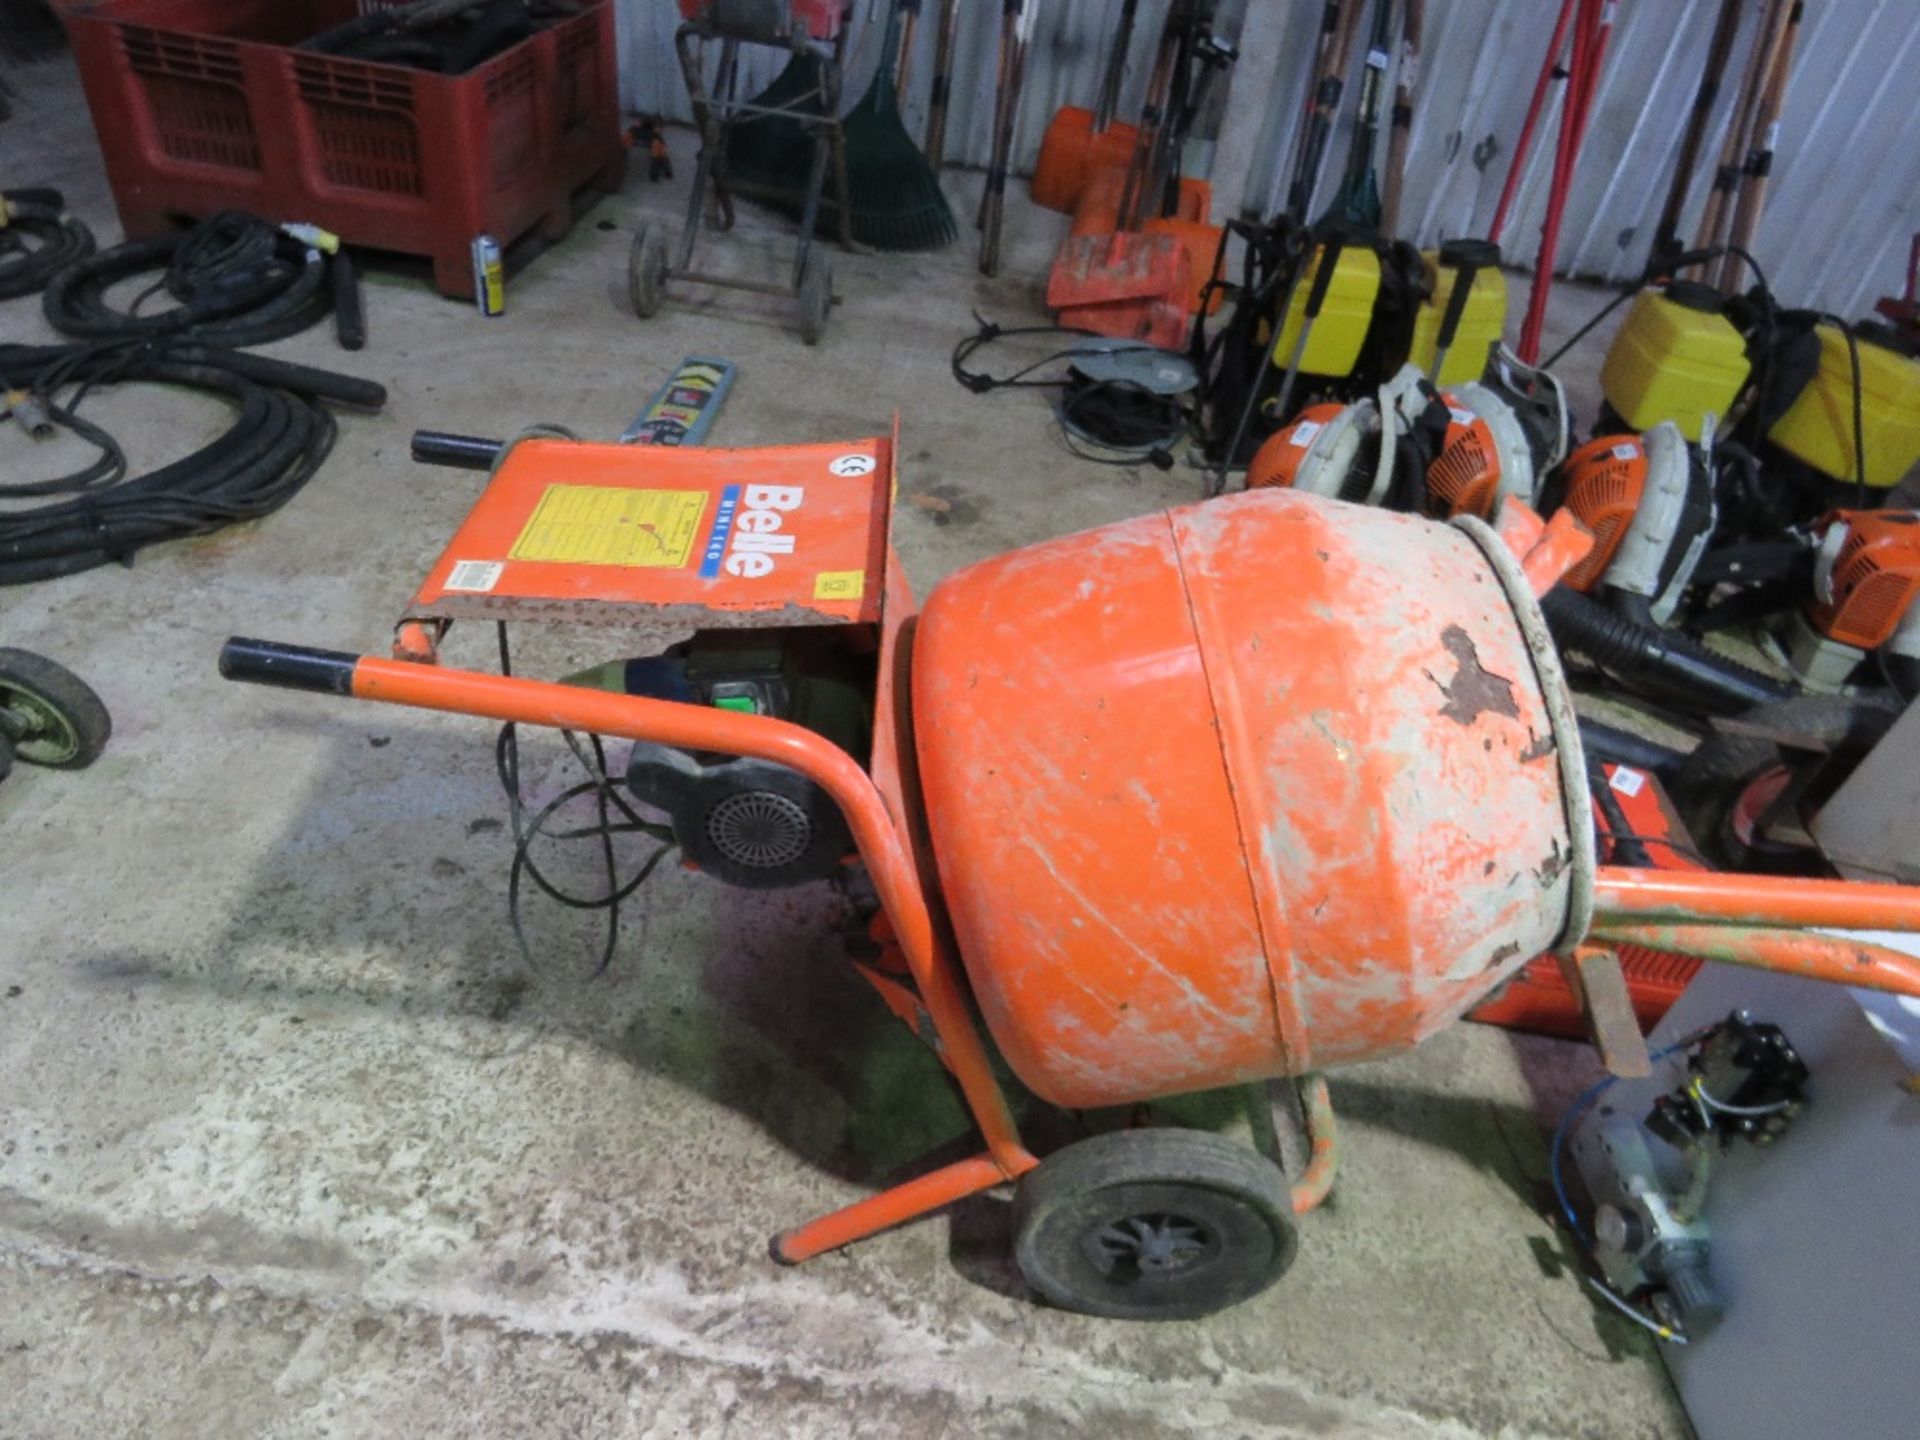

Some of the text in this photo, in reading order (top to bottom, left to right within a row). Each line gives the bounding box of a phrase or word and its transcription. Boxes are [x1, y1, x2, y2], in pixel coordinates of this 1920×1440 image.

[841, 456, 867, 474] CE
[714, 500, 735, 529] MINI
[725, 484, 804, 578] Belle
